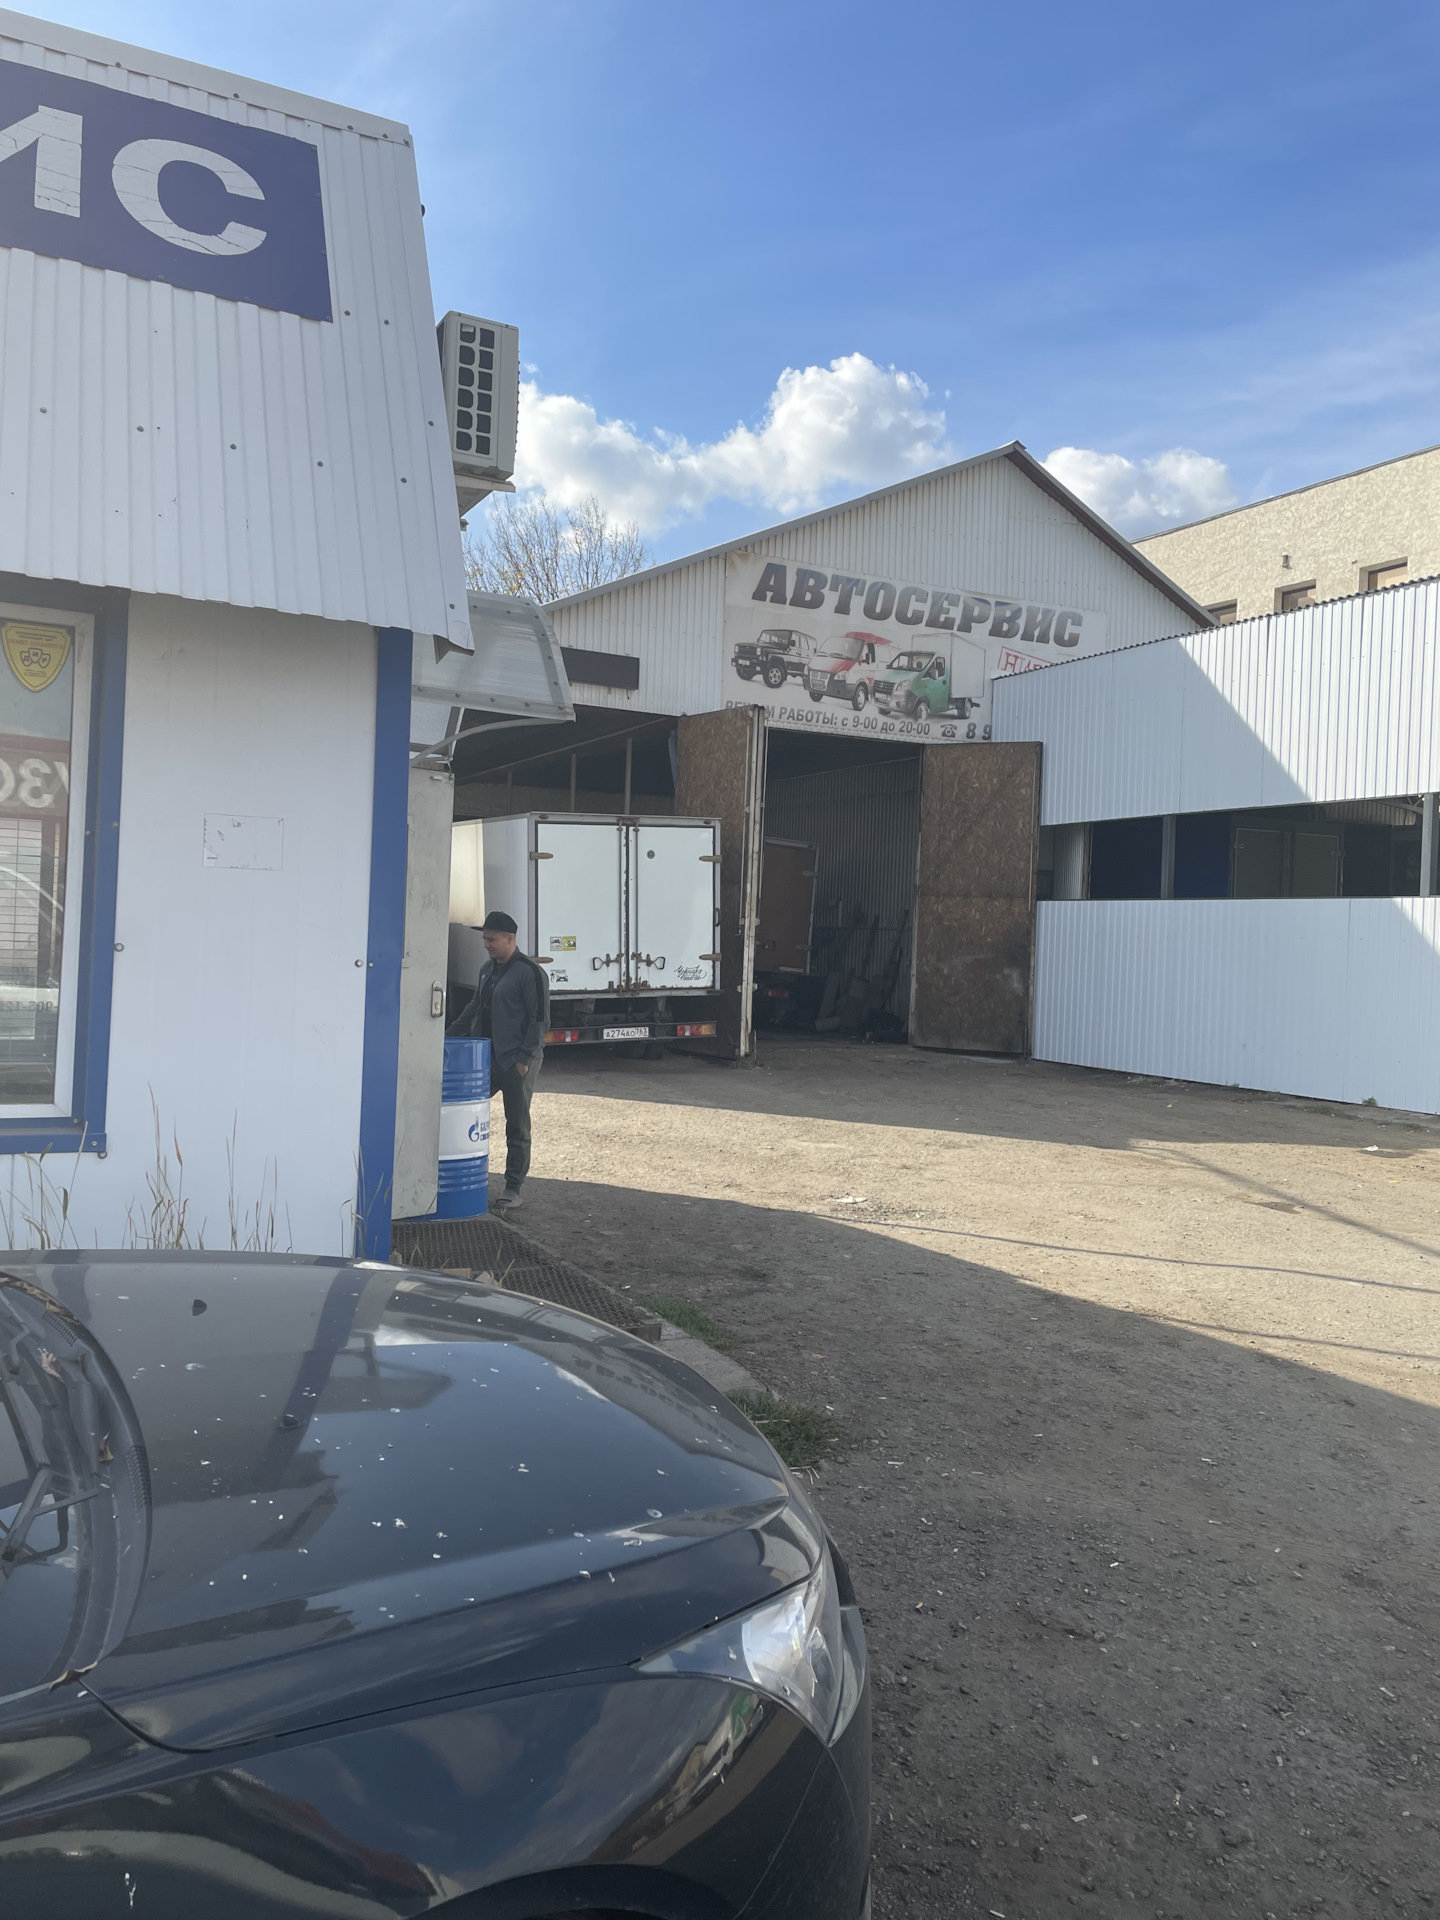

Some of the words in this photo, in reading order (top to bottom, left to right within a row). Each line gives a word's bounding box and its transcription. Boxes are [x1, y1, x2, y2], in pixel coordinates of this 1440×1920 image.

[751, 562, 1084, 648] АВТОСЕРВИС
[779, 707, 838, 726] РАБОТЫ:
[852, 716, 878, 730] 9-00
[880, 722, 895, 733] до
[899, 720, 931, 735] 20-00
[965, 722, 977, 740] 8
